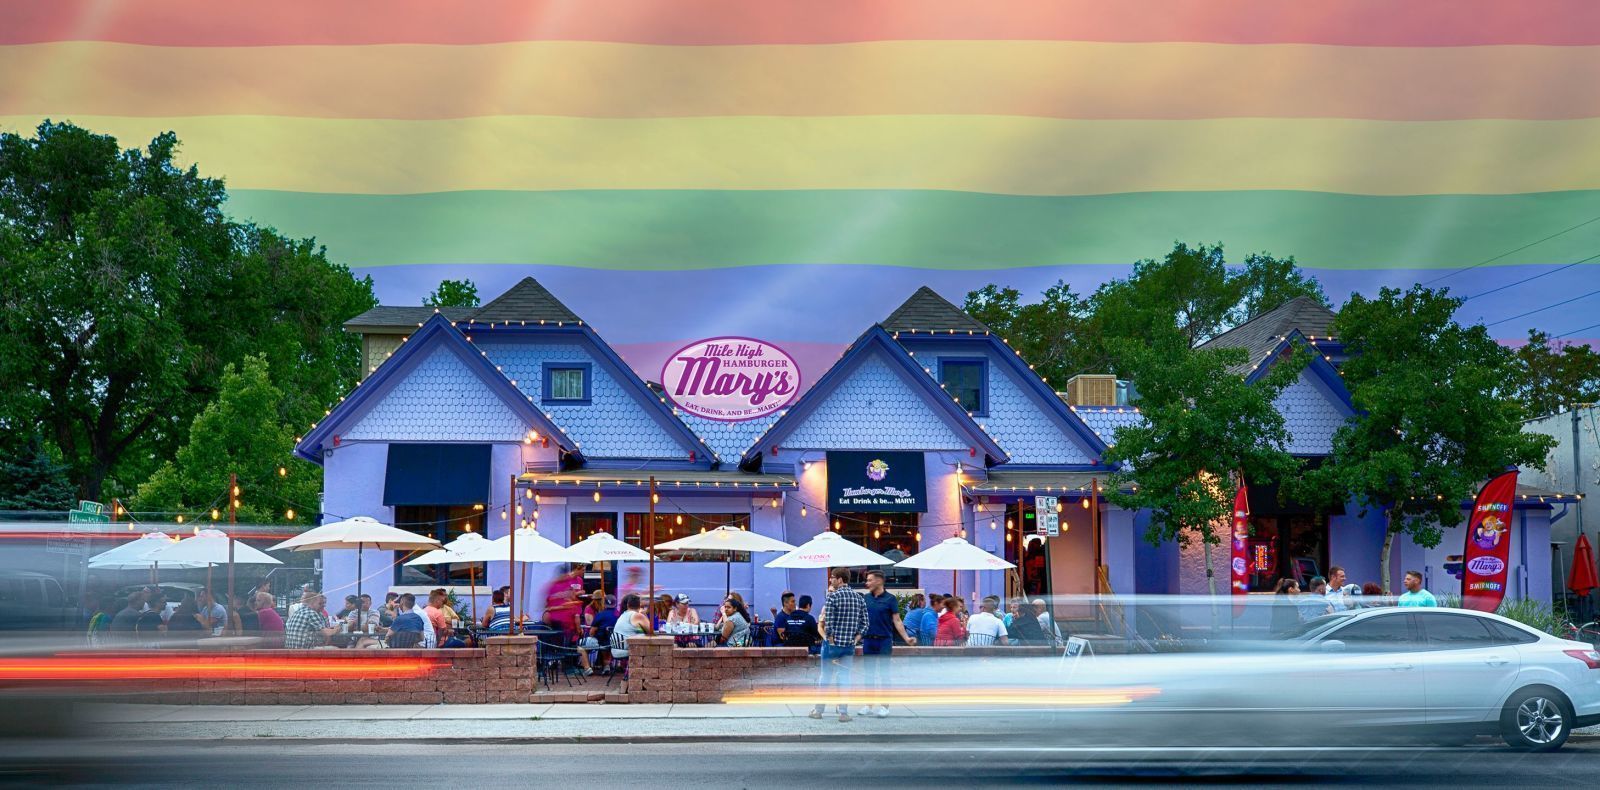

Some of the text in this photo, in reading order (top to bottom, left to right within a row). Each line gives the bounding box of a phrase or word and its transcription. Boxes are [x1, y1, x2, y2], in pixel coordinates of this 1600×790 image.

[704, 344, 764, 359] Mile High
[723, 360, 788, 368] HAMBURGER
[675, 357, 794, 405] Mary's
[684, 401, 699, 410] EAT,
[701, 407, 725, 416] DRINK,
[843, 486, 884, 497] Hamburger
[1477, 503, 1508, 512] SMIRNOFF
[1471, 560, 1502, 572] Mary's
[1469, 582, 1501, 590] SMIRNOFF
